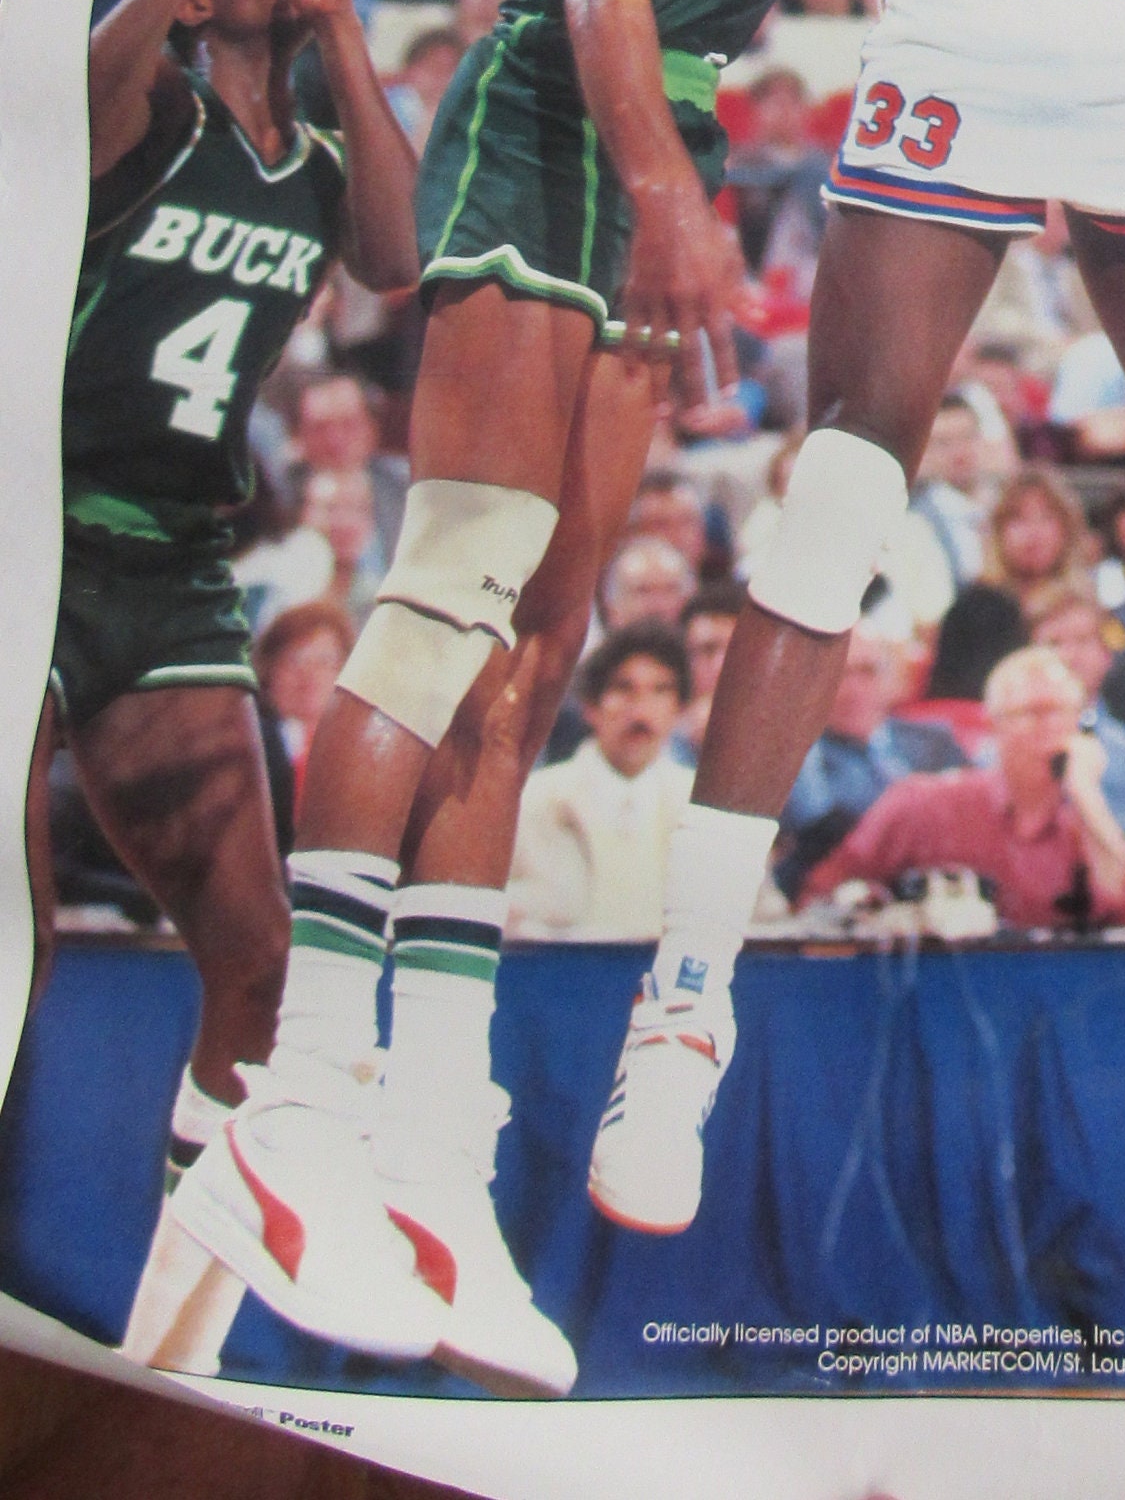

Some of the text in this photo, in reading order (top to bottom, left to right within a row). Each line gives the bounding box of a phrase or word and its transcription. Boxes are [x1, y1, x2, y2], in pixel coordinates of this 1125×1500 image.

[854, 80, 962, 170] 33
[127, 203, 324, 297] BUCK
[150, 296, 254, 442] 4
[642, 1321, 730, 1347] Officially
[734, 1322, 820, 1343] licensed
[825, 1323, 906, 1348] product
[910, 1324, 931, 1344] of
[935, 1324, 978, 1344] NBA
[982, 1324, 1088, 1347] Properties,
[817, 1350, 918, 1376] Copyright
[923, 1351, 1085, 1378] MARKETCOM/St.
[279, 1411, 356, 1438] Poster
